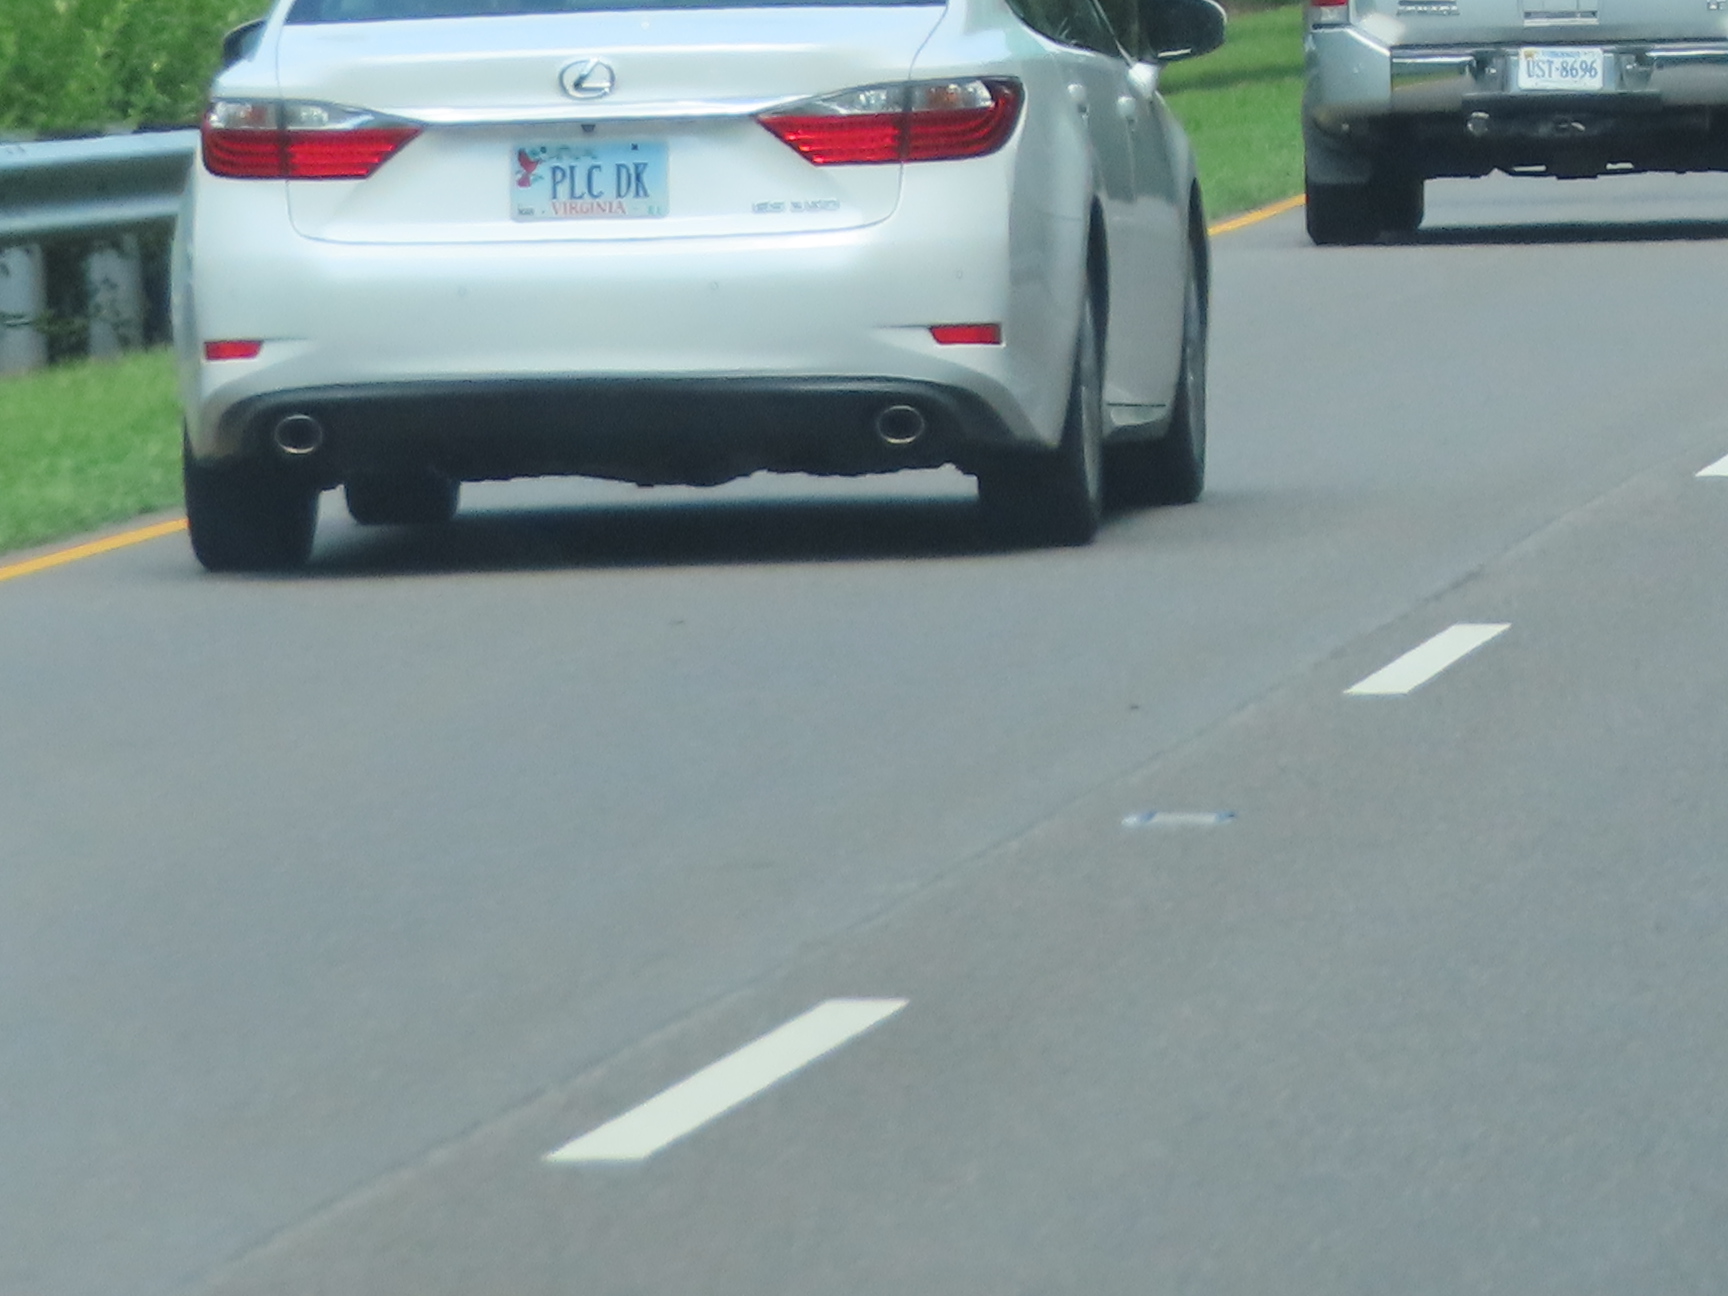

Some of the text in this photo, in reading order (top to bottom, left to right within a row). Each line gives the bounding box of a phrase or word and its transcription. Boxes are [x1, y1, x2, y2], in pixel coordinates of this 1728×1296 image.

[550, 161, 650, 200] PLC DK
[551, 200, 627, 216] VIRGINIA
